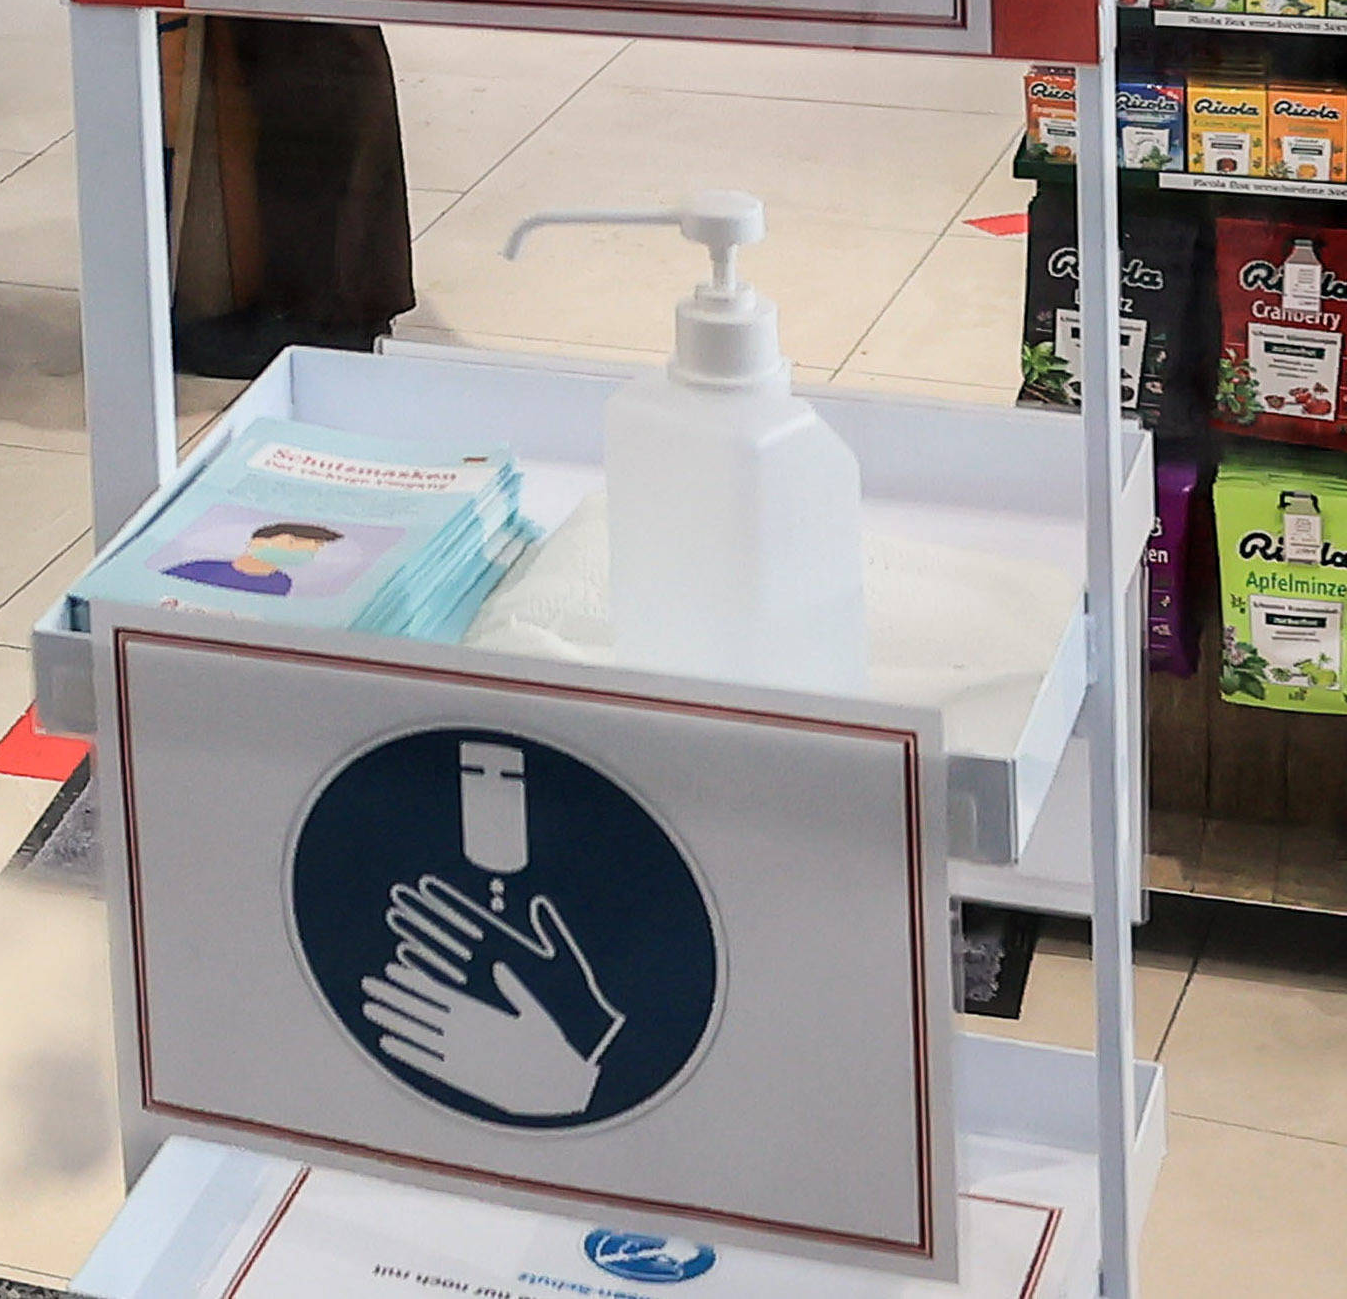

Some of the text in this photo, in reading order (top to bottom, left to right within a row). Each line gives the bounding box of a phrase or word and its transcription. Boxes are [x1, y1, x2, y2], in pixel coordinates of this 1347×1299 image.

[1031, 83, 1076, 101] Rico
[1116, 94, 1178, 111] Ricola
[1194, 99, 1259, 116] Ricola
[1273, 101, 1340, 119] Ricola
[1253, 301, 1341, 330] Cranberry
[1239, 533, 1347, 566] Rila
[1246, 571, 1347, 598] Apfelminze
